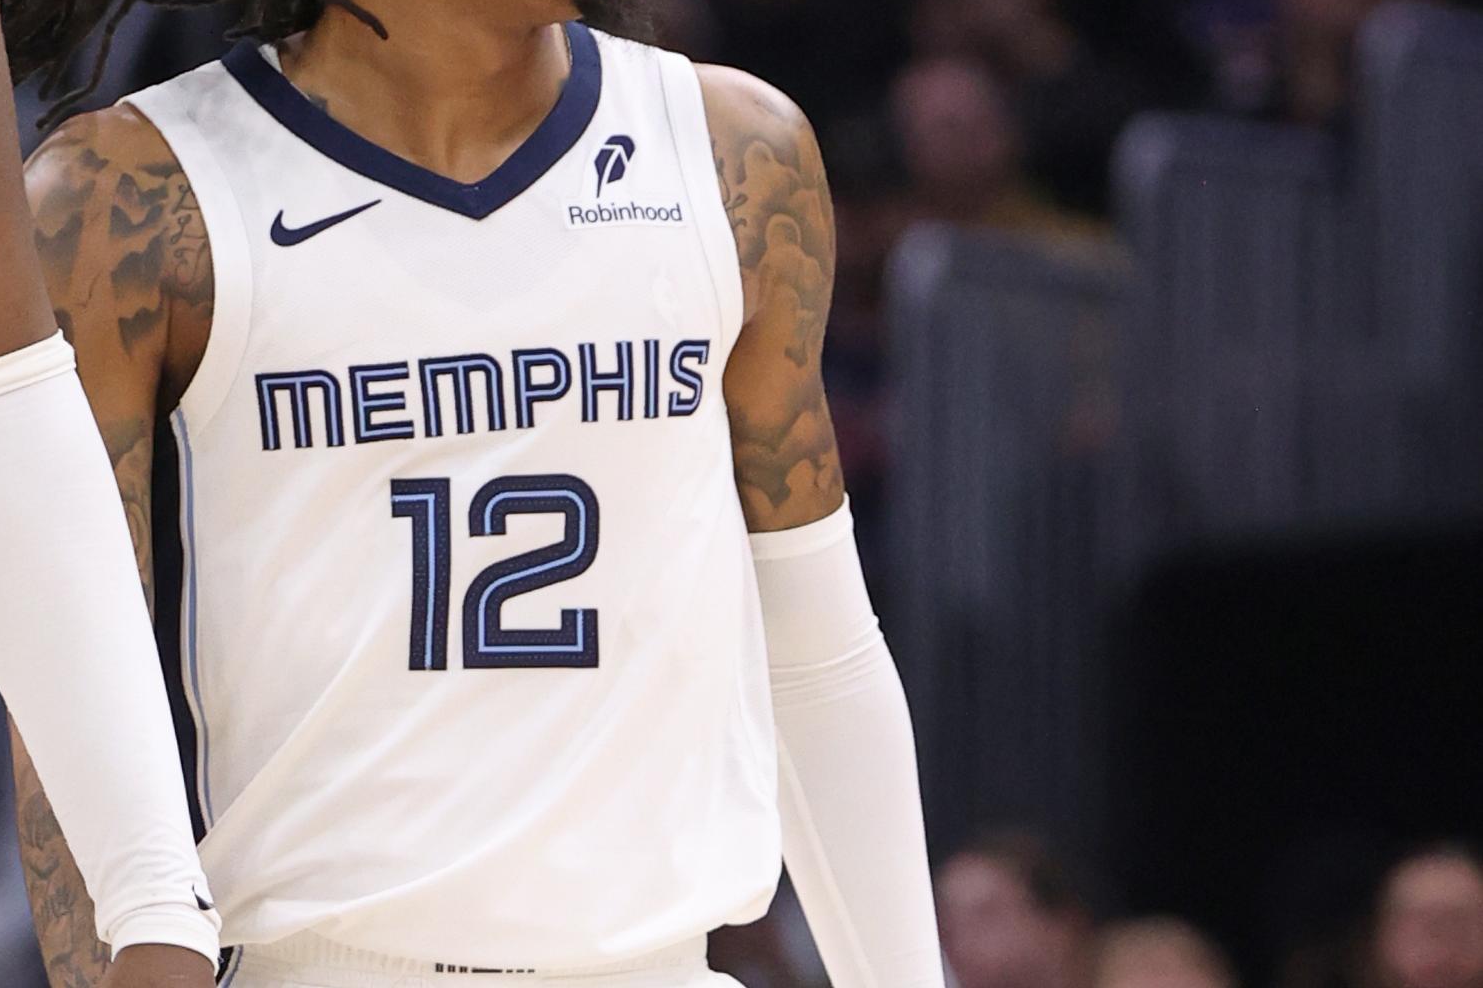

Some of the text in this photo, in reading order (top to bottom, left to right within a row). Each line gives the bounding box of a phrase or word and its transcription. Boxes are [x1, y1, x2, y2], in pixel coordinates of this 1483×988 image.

[569, 202, 683, 225] Robinhood
[255, 339, 711, 451] MEMPHIS
[390, 474, 600, 671] 12
